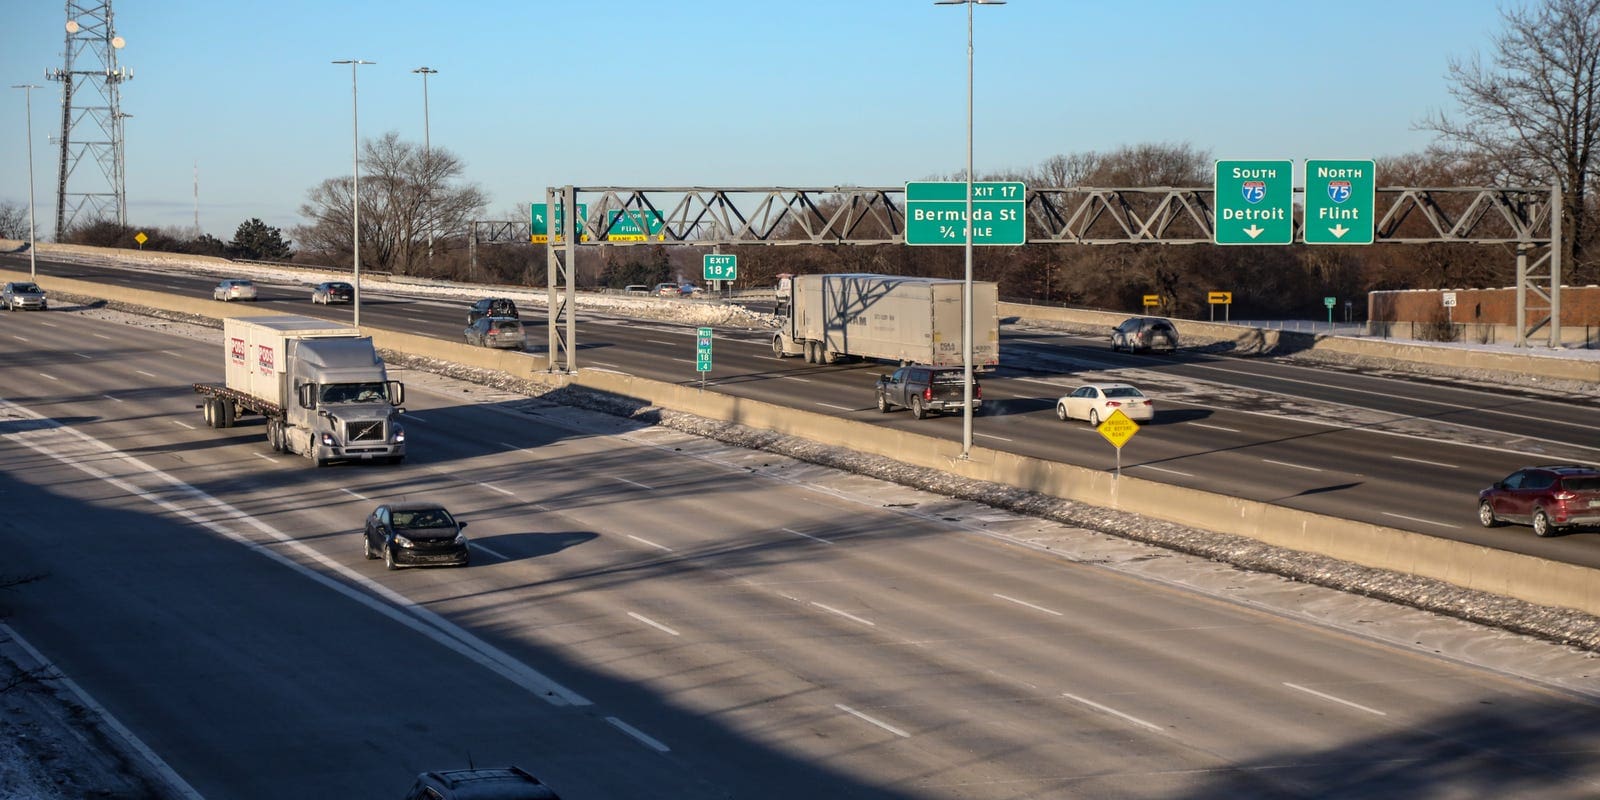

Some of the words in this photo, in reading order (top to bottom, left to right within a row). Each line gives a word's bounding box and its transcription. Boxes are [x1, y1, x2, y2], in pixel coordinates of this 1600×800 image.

[1232, 167, 1277, 179] SOUTH
[1317, 167, 1363, 178] NORTH
[971, 187, 994, 196] XIT
[1001, 186, 1017, 197] 17
[1244, 187, 1265, 199] 75
[1330, 186, 1350, 199] 75
[914, 208, 993, 221] Bermuda
[999, 208, 1017, 221] St
[1223, 207, 1284, 220] Detroit
[1319, 207, 1359, 220] Flint
[708, 265, 723, 275] 18
[701, 353, 709, 361] 18
